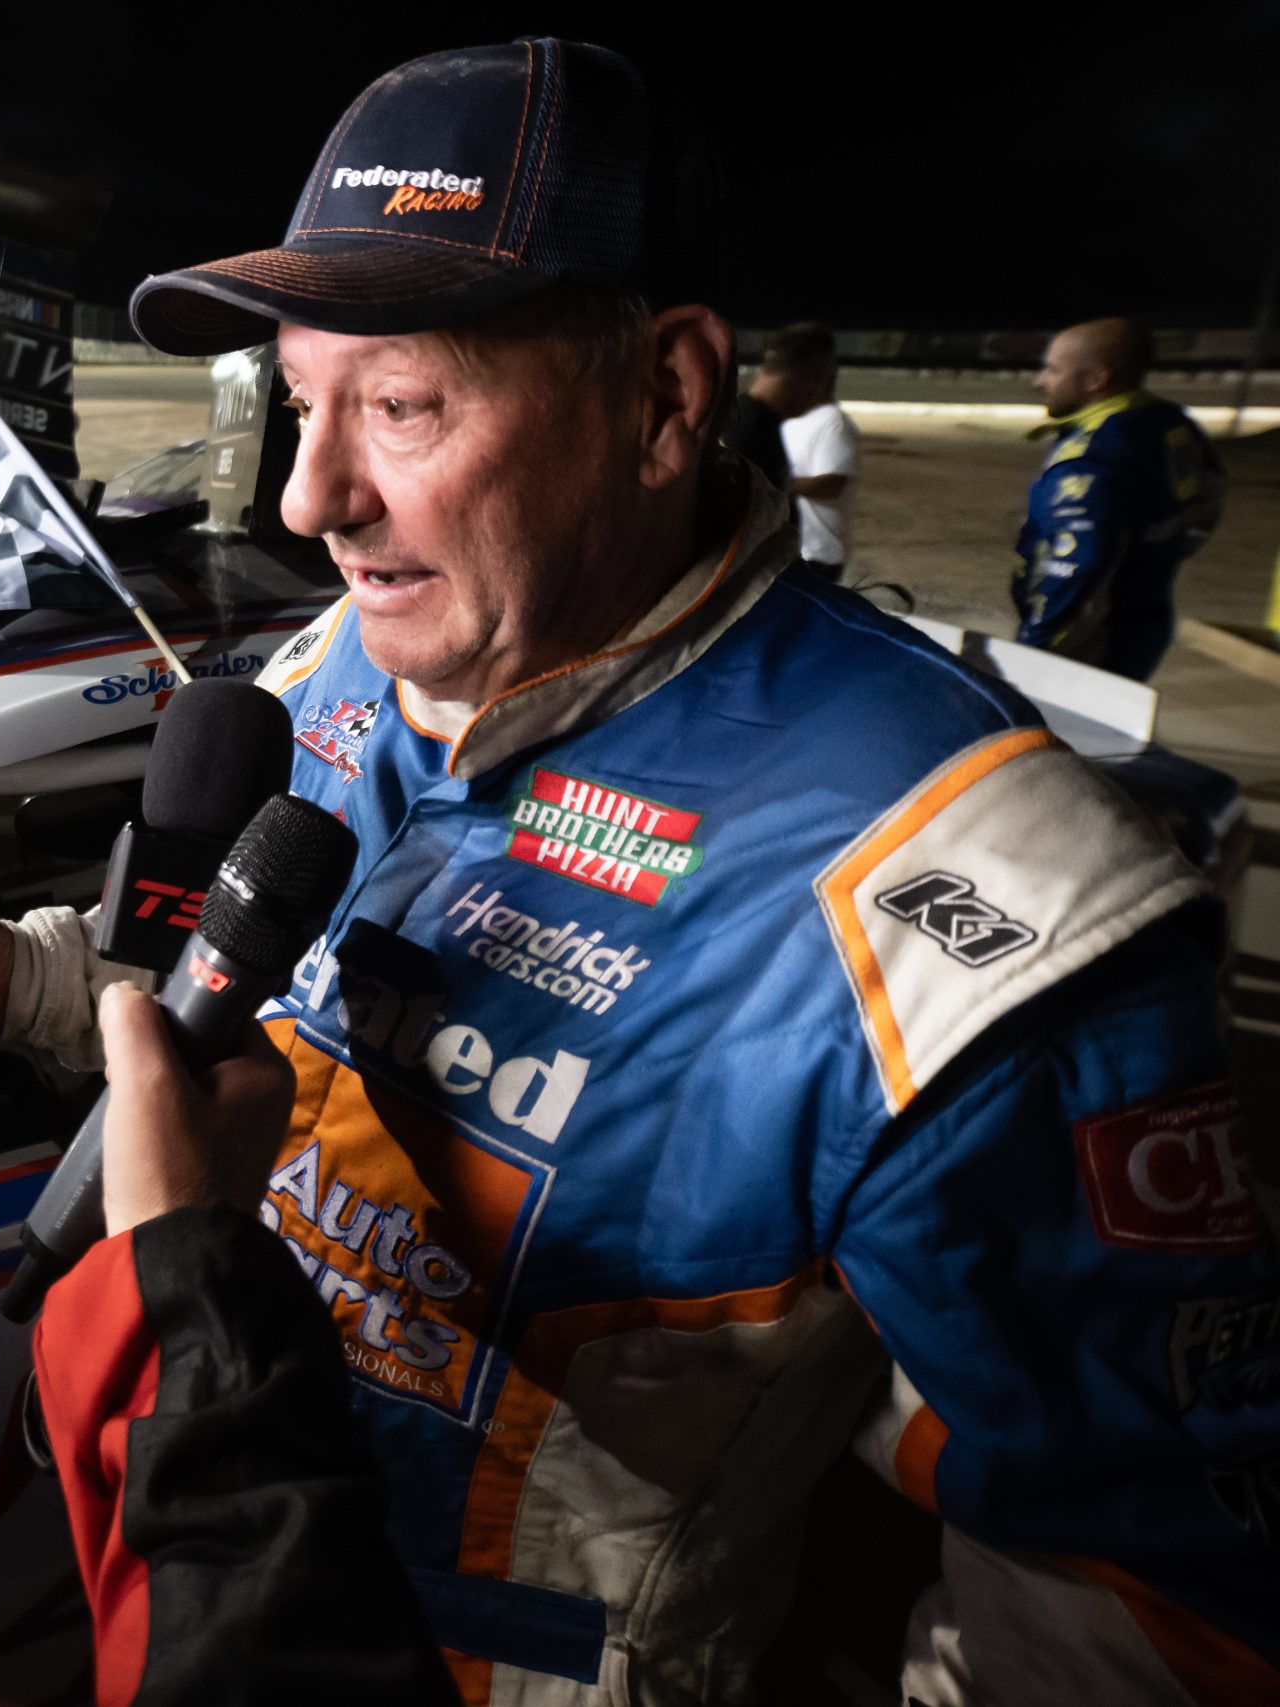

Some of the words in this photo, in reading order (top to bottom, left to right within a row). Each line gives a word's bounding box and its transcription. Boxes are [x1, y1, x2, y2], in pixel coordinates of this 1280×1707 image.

[331, 165, 484, 197] Federated
[512, 799, 694, 874] BROTHERS
[560, 779, 669, 836] HUNT
[536, 836, 642, 892] PIZZA
[445, 882, 652, 990] Hendrick
[468, 938, 618, 1016] cars.com
[269, 1139, 472, 1299] Auto
